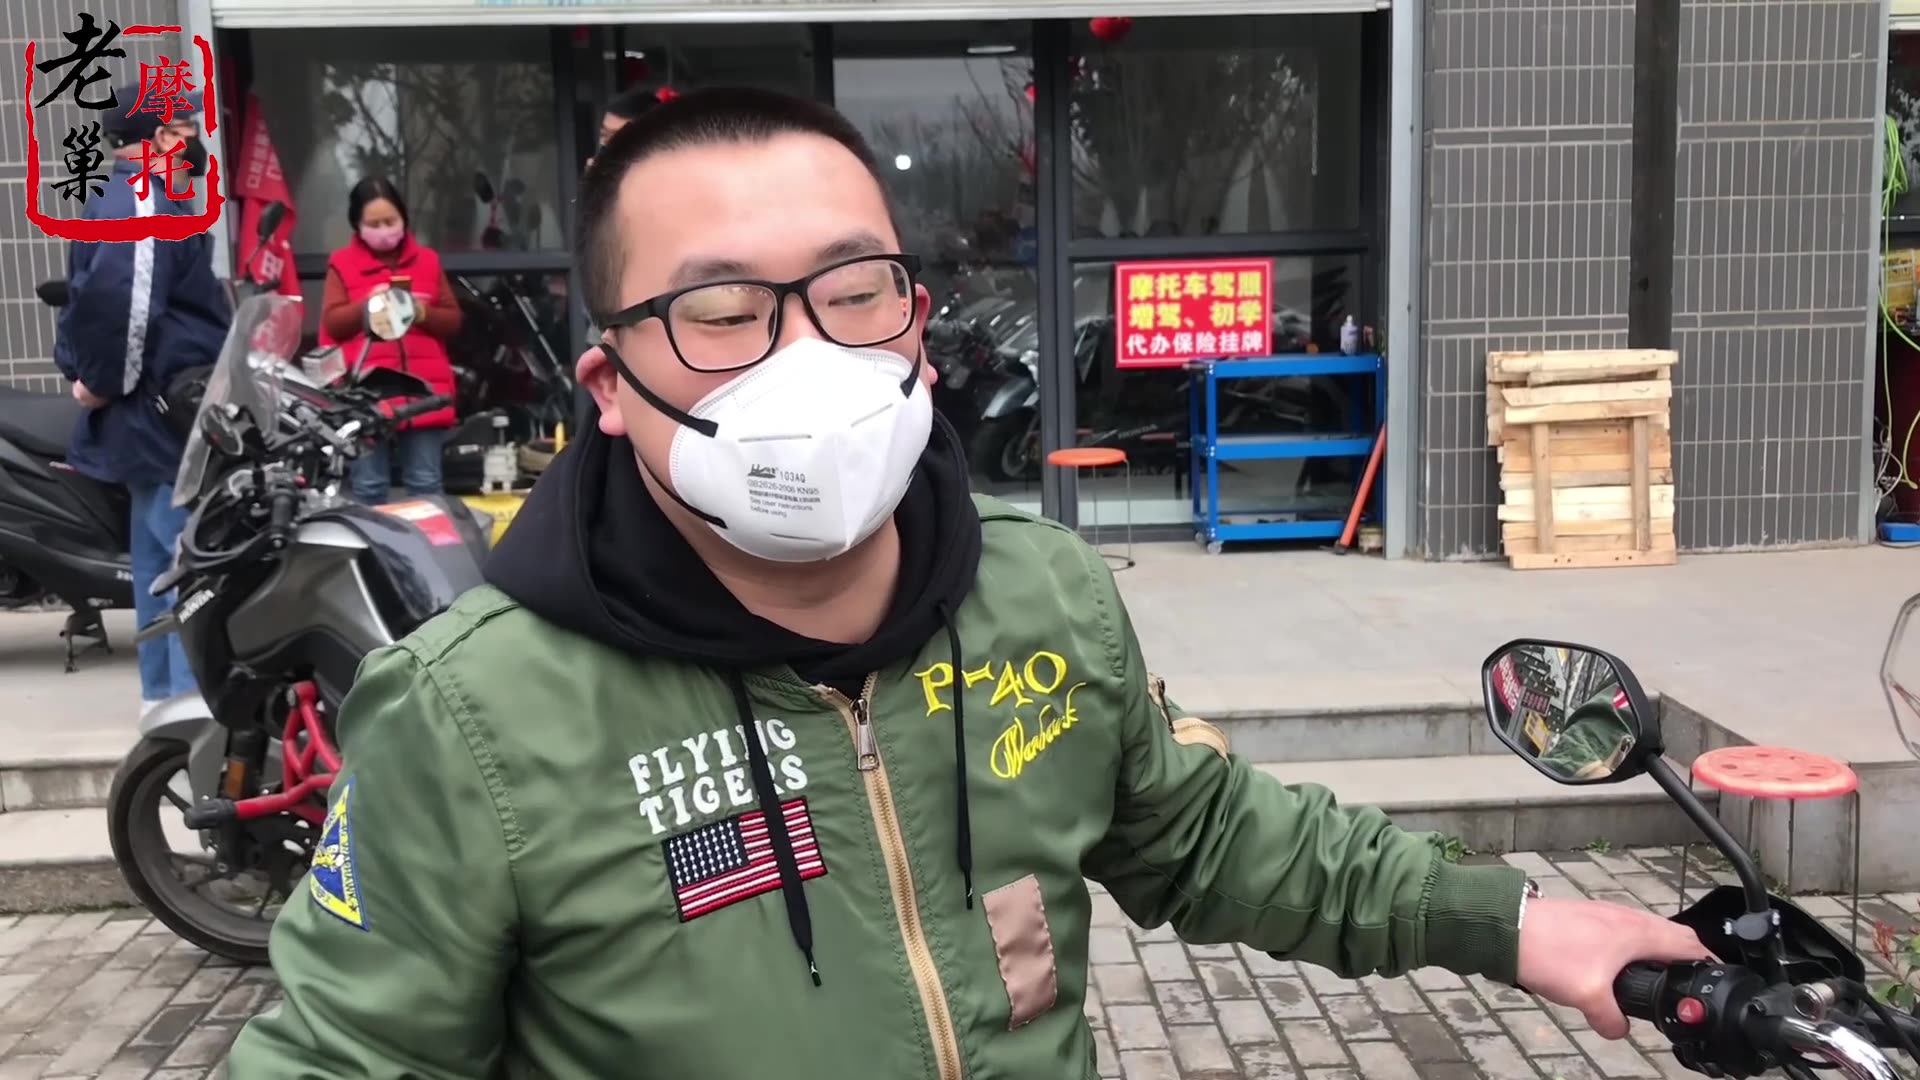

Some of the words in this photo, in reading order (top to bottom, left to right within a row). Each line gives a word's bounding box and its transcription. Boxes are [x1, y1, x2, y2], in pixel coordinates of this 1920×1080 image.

[1128, 271, 1263, 301] 摩托车驾照
[1127, 331, 1263, 355] 代办保险挂牌
